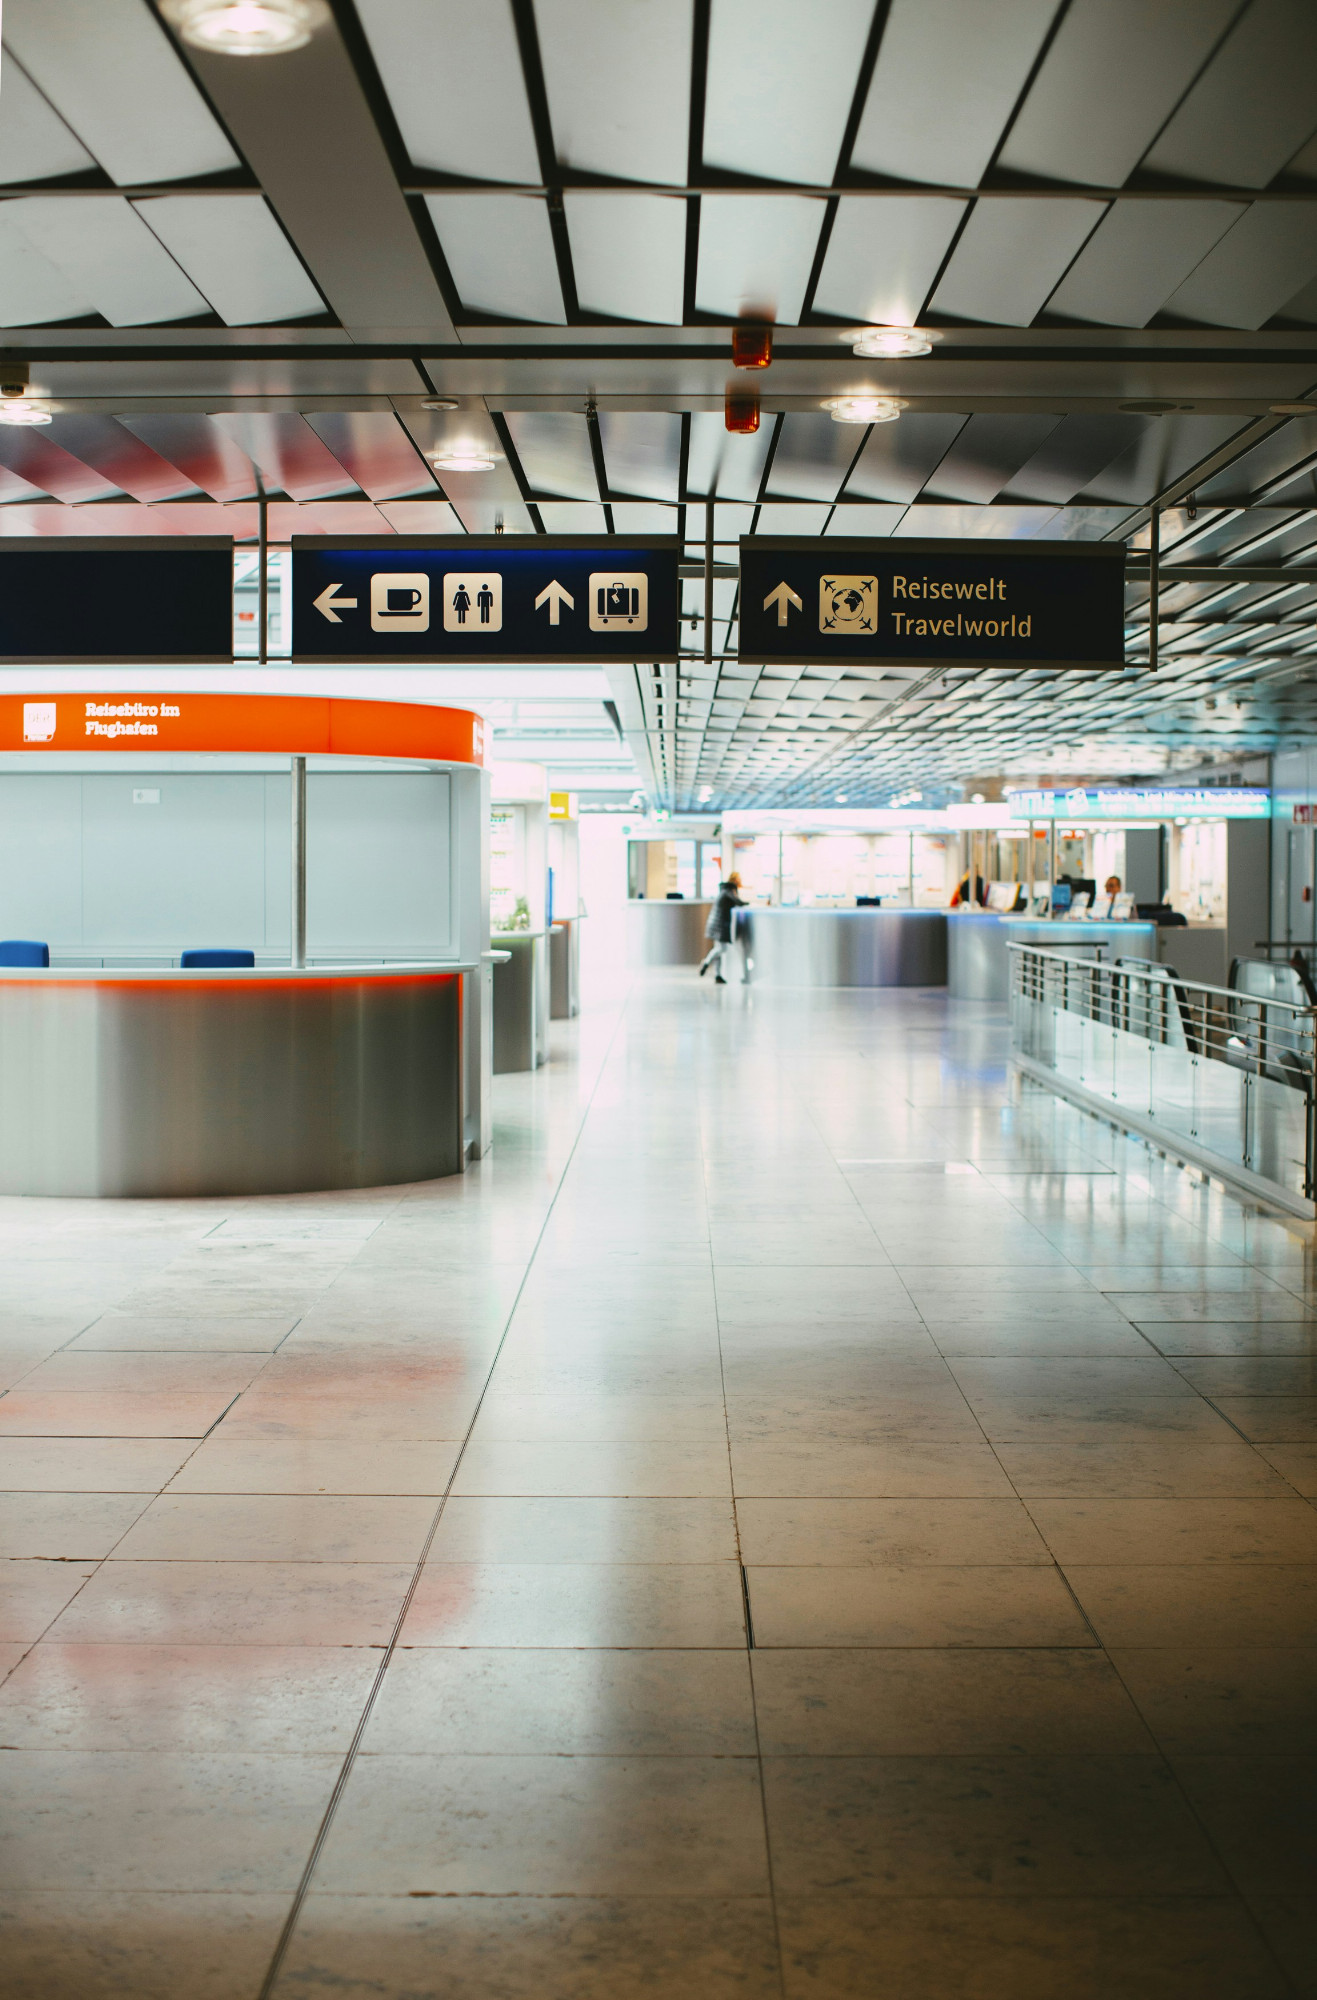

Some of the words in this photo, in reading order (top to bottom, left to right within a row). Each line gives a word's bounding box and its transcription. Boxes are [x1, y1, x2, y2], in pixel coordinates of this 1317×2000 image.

[892, 575, 1007, 601] Reisewelt
[891, 612, 1032, 637] Travelworld
[85, 702, 158, 717] Reisebüro
[160, 703, 180, 717] im
[85, 721, 158, 738] Flughafen
